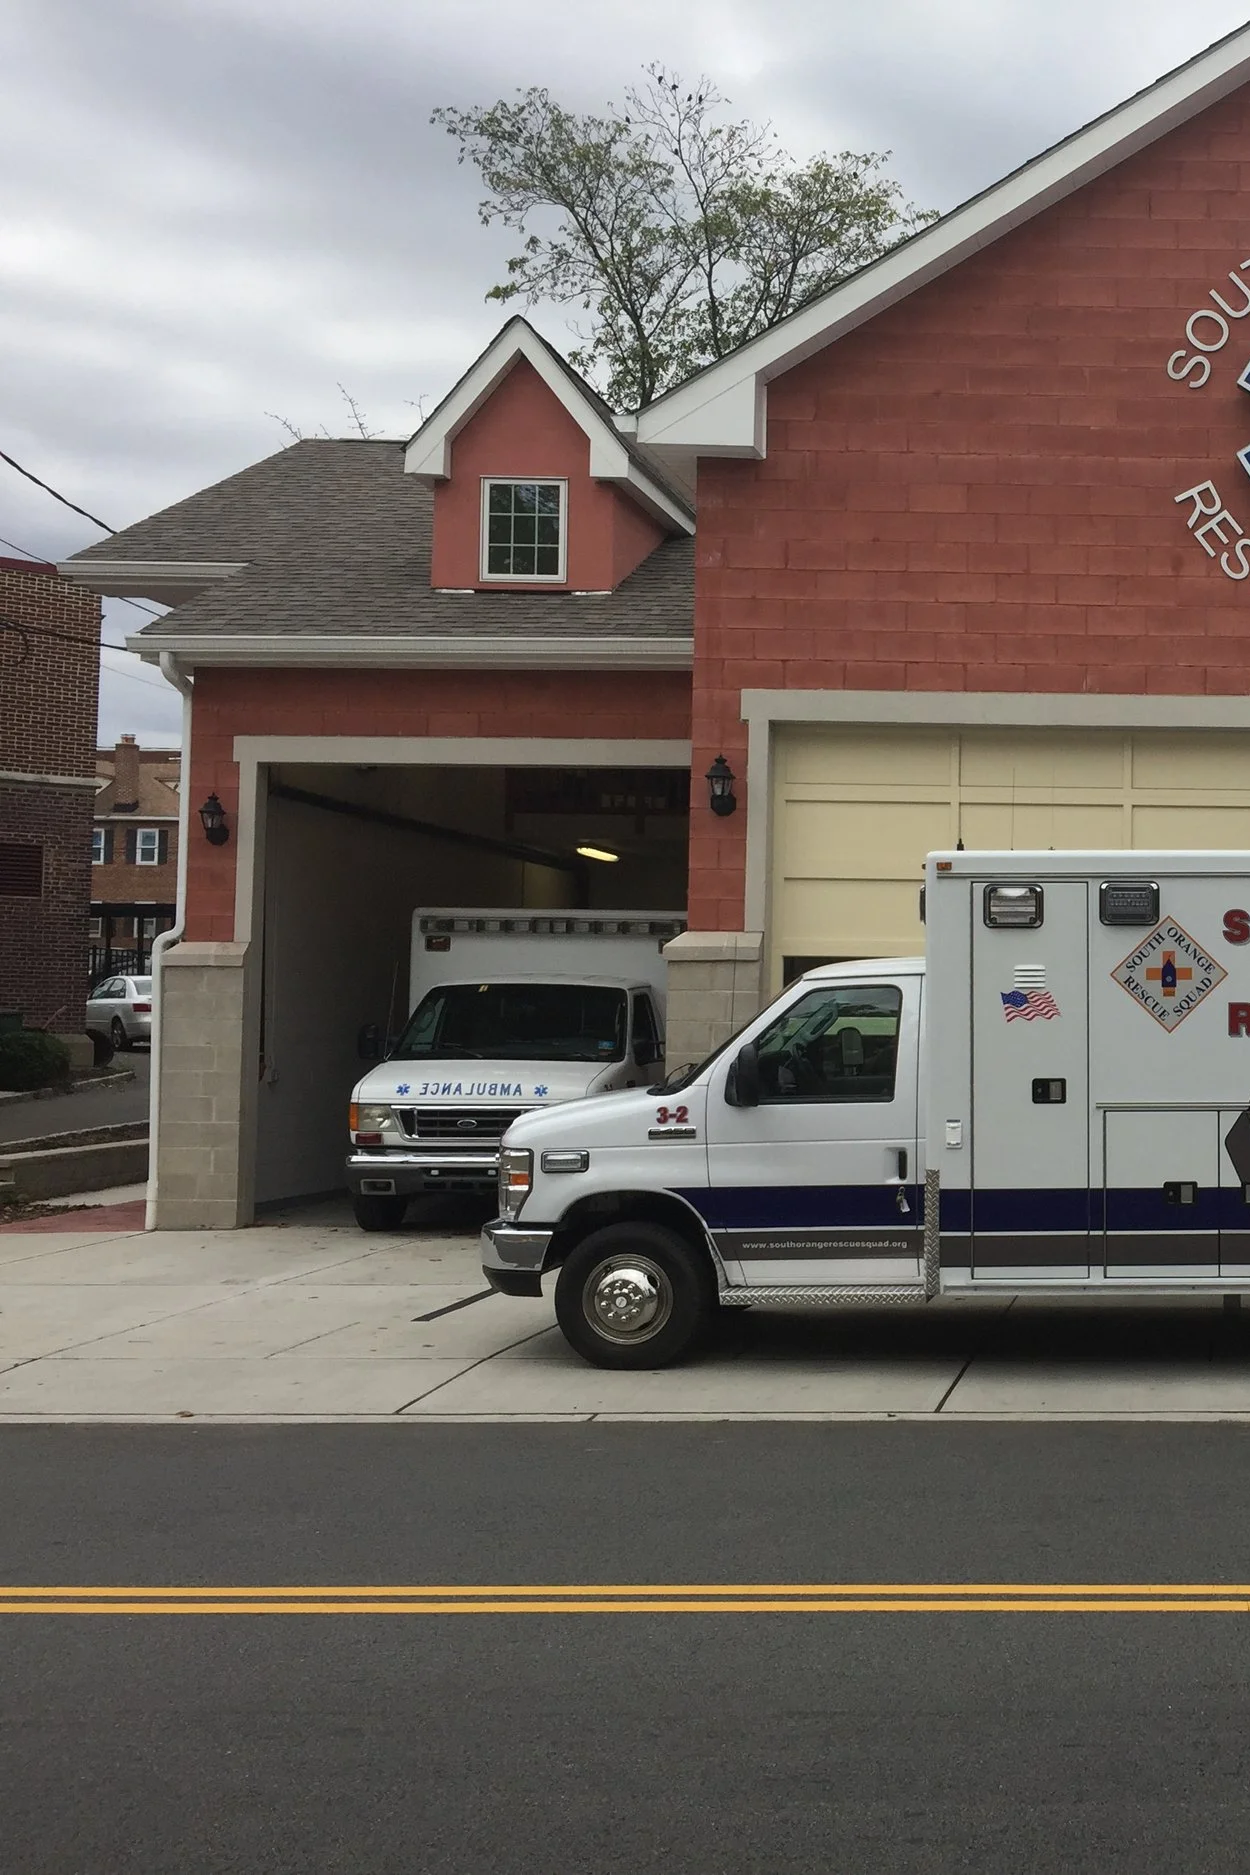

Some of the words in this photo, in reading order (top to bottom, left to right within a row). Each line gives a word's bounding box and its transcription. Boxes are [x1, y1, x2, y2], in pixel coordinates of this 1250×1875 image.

[1125, 932, 1165, 973] SOUTH
[1167, 926, 1216, 975] ORANGE
[1123, 975, 1170, 1021] RESCUE
[1173, 977, 1213, 1017] SQUAD
[656, 1105, 689, 1124] 3-2
[742, 1240, 908, 1249] www.southorangerescuesquad.org
